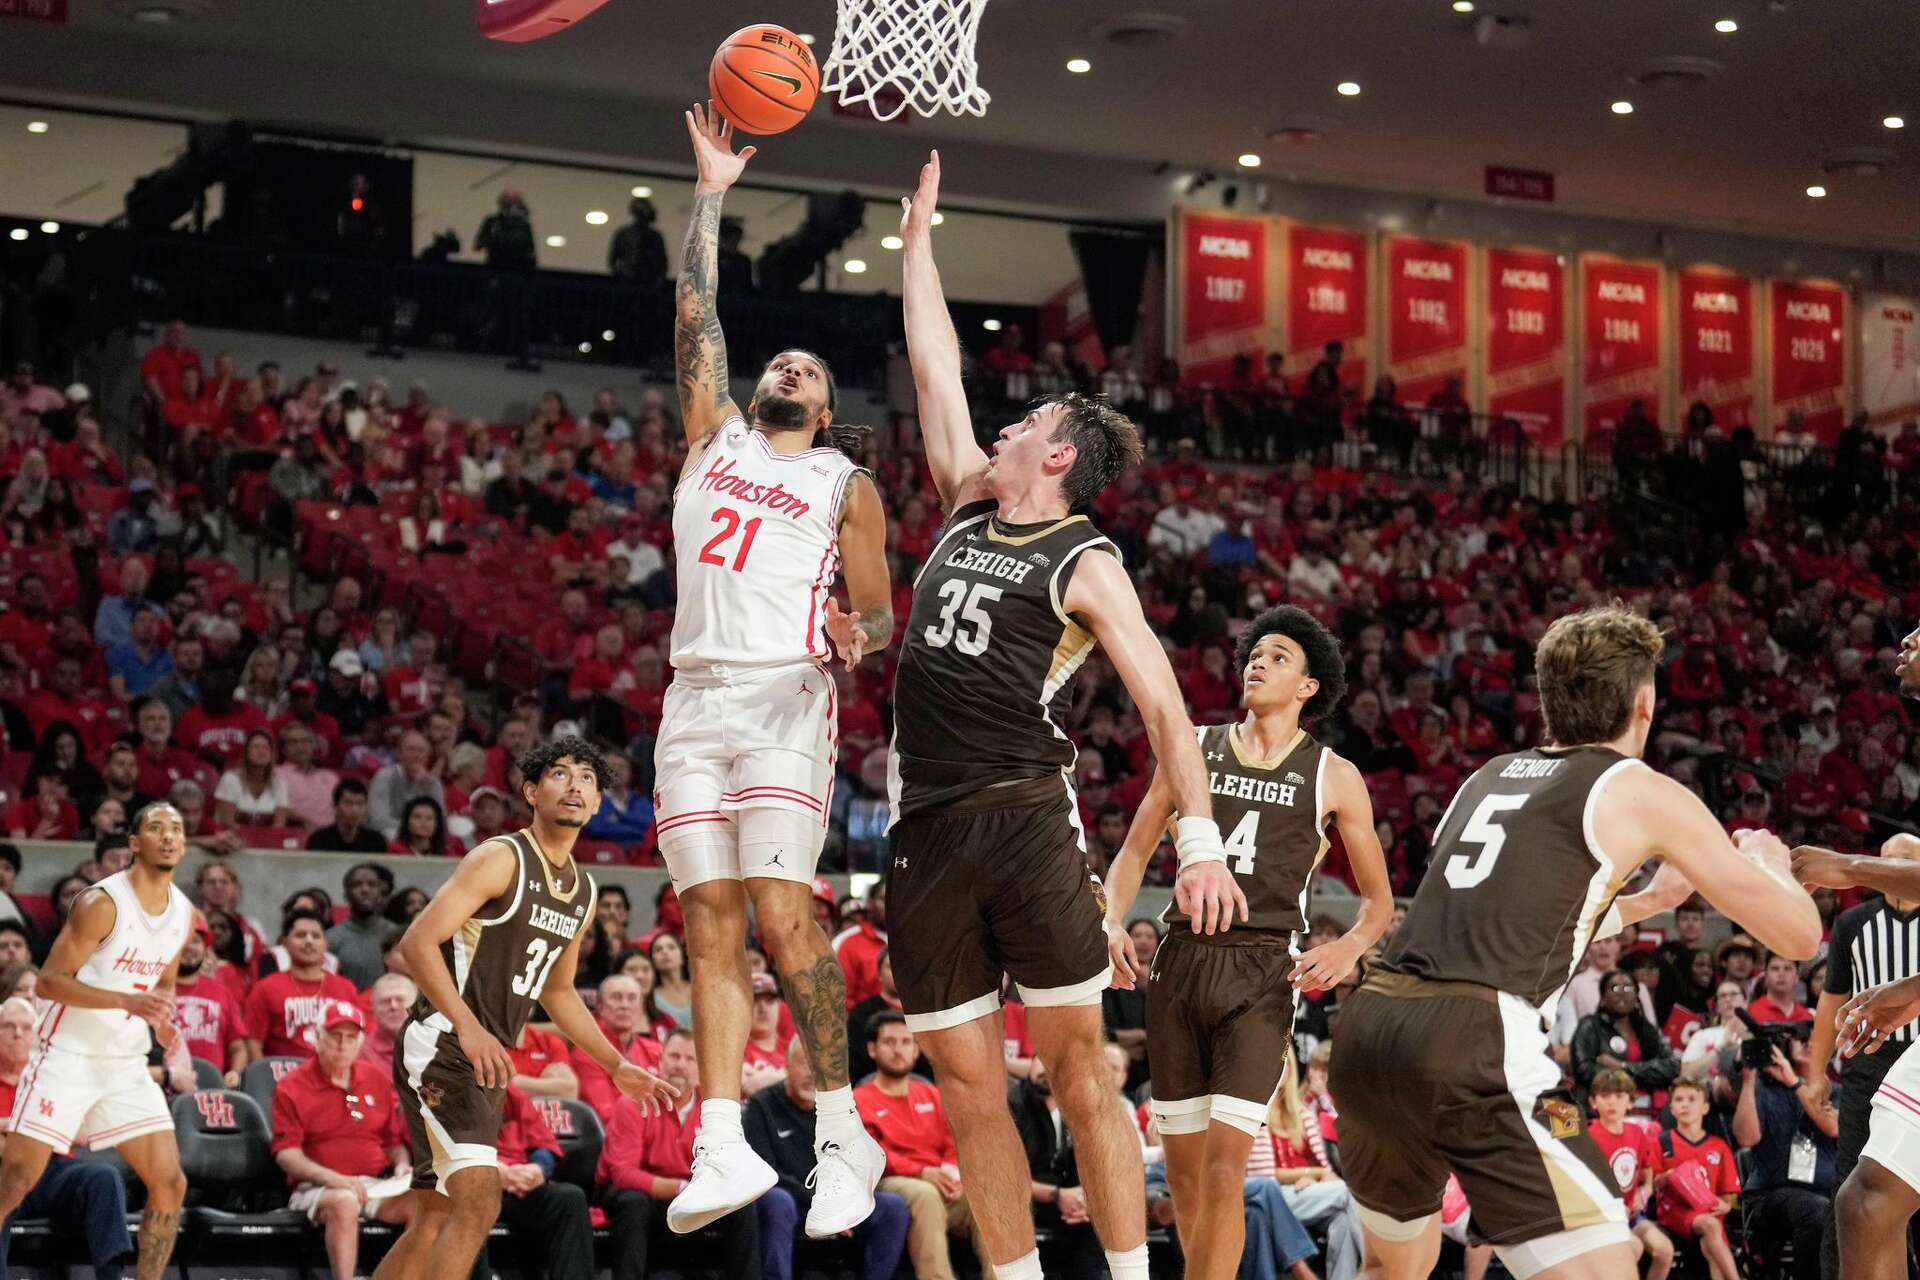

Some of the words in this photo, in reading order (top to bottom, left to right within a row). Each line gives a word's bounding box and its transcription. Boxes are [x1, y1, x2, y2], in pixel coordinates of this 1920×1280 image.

[761, 31, 812, 67] ELITE
[1199, 235, 1250, 260] NCAA
[1303, 247, 1353, 271] NCAA
[1403, 258, 1452, 283] NCAA
[1502, 268, 1549, 292] NCAA
[1598, 280, 1645, 304] NCAA
[1692, 291, 1738, 314] NCAA
[1785, 301, 1831, 323] NCAA
[1698, 328, 1732, 354] 2021
[1791, 337, 1825, 363] 2025
[699, 456, 810, 520] Houston
[698, 507, 763, 572] 21
[944, 546, 1034, 584] LEHIGH
[924, 578, 1004, 656] 35
[1499, 758, 1566, 778] BENOIT
[1209, 771, 1297, 807] LEHIGH
[1224, 810, 1260, 875] 4
[1444, 793, 1530, 889] 5
[528, 903, 579, 940] LEHIGH
[512, 937, 563, 1000] 31
